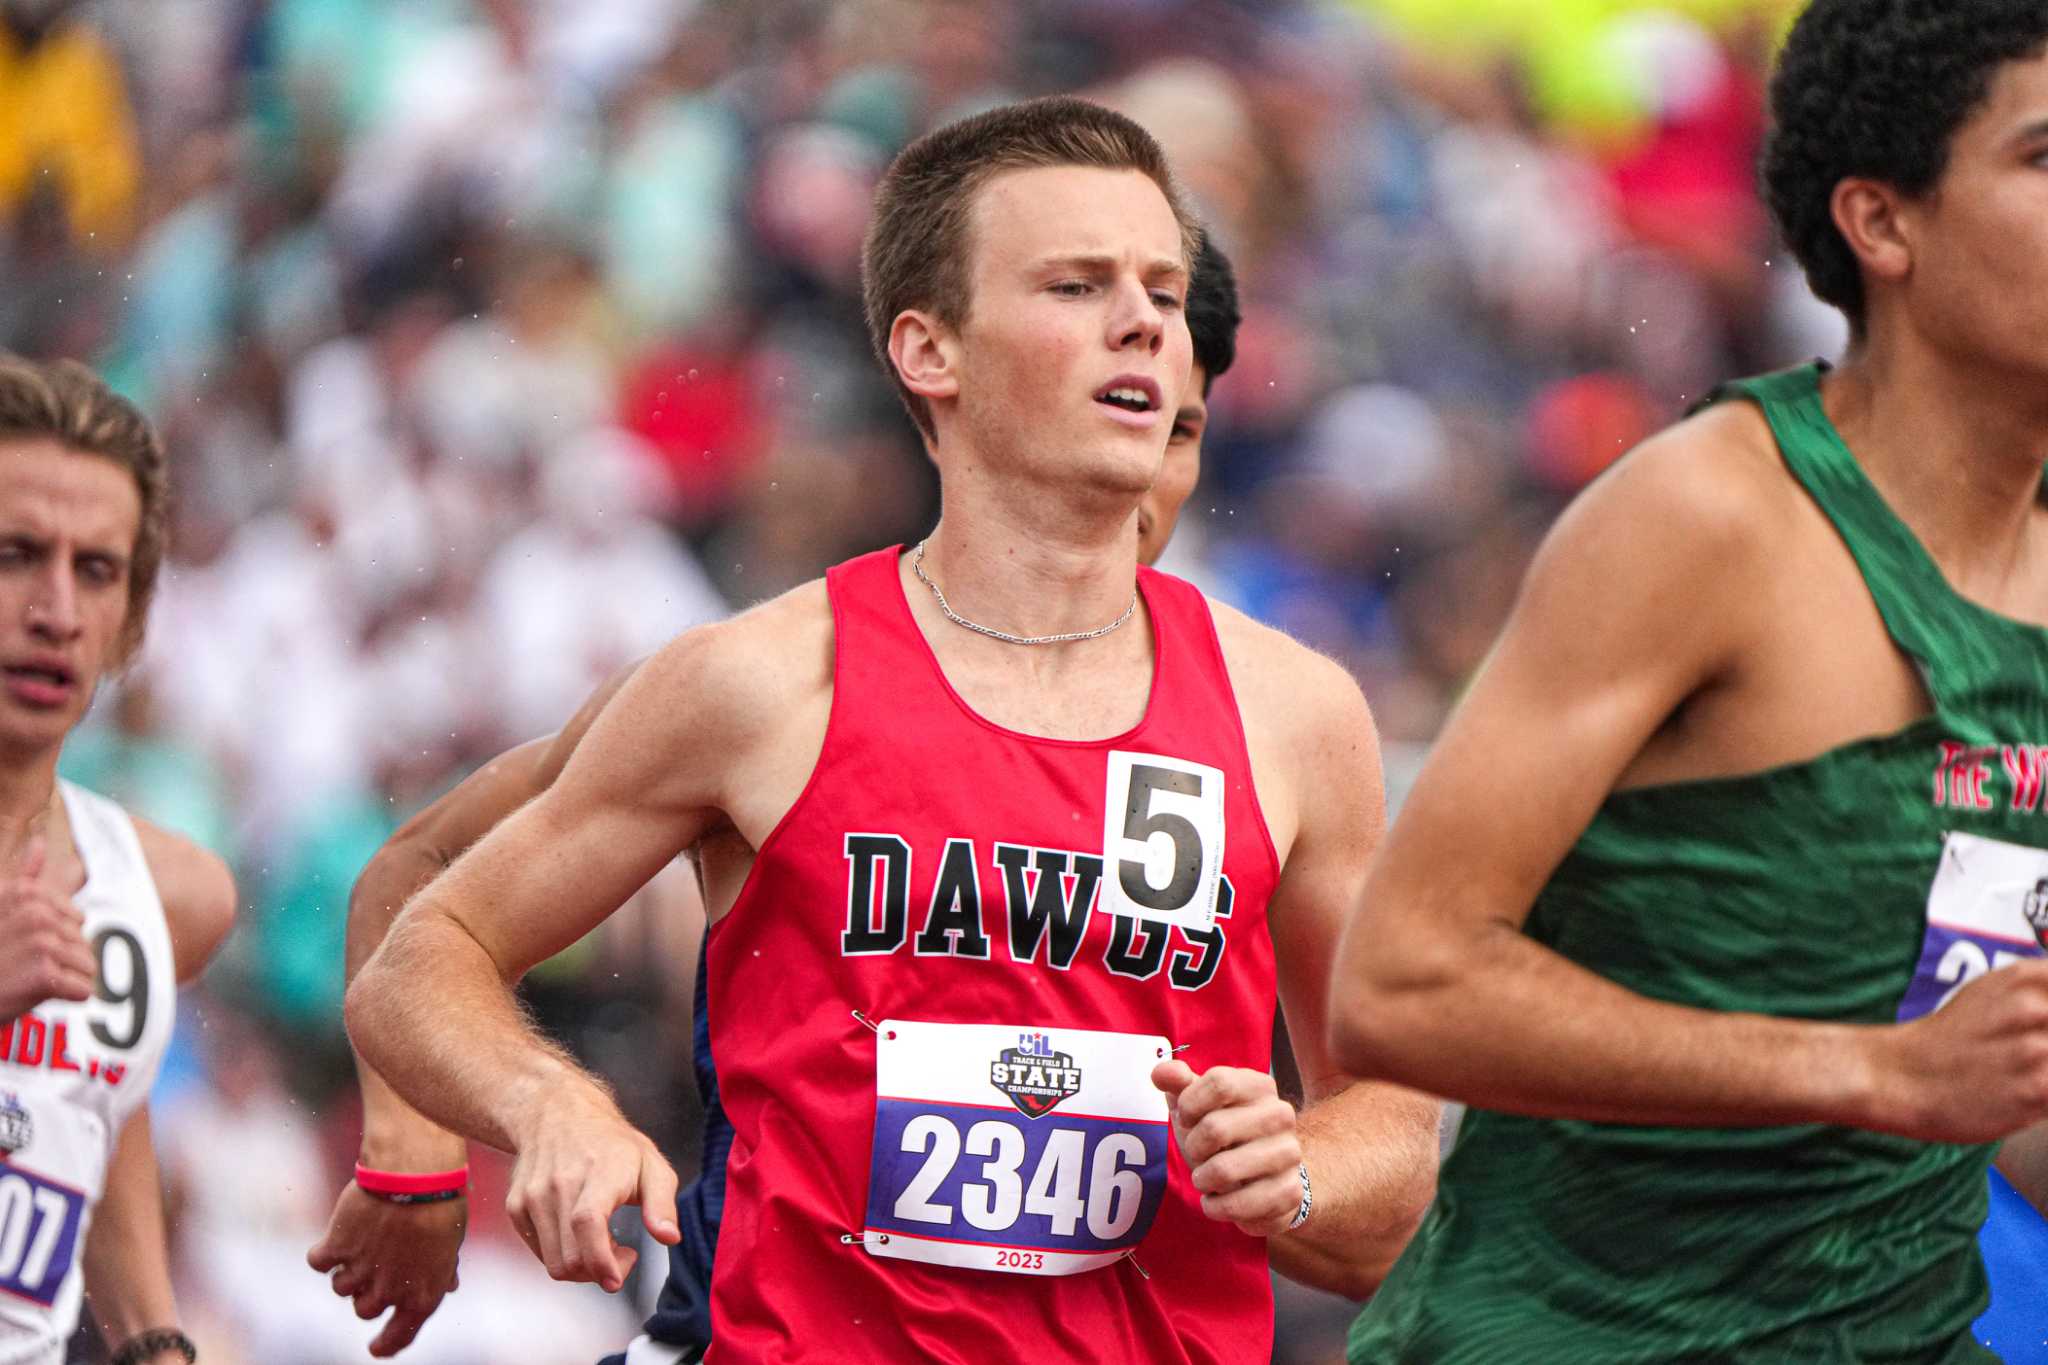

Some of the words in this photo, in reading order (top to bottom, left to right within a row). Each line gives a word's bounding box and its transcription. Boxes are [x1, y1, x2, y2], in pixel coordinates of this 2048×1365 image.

[1934, 741, 1996, 809] THE
[1118, 764, 1203, 911] 5
[88, 928, 149, 1050] 9
[992, 1062, 1080, 1090] STATE
[1014, 1057, 1034, 1065] TRACK
[1007, 1085, 1062, 1097] CHAMPIONSHIPS
[893, 1113, 1147, 1241] 2346
[996, 1251, 1043, 1270] 2023
